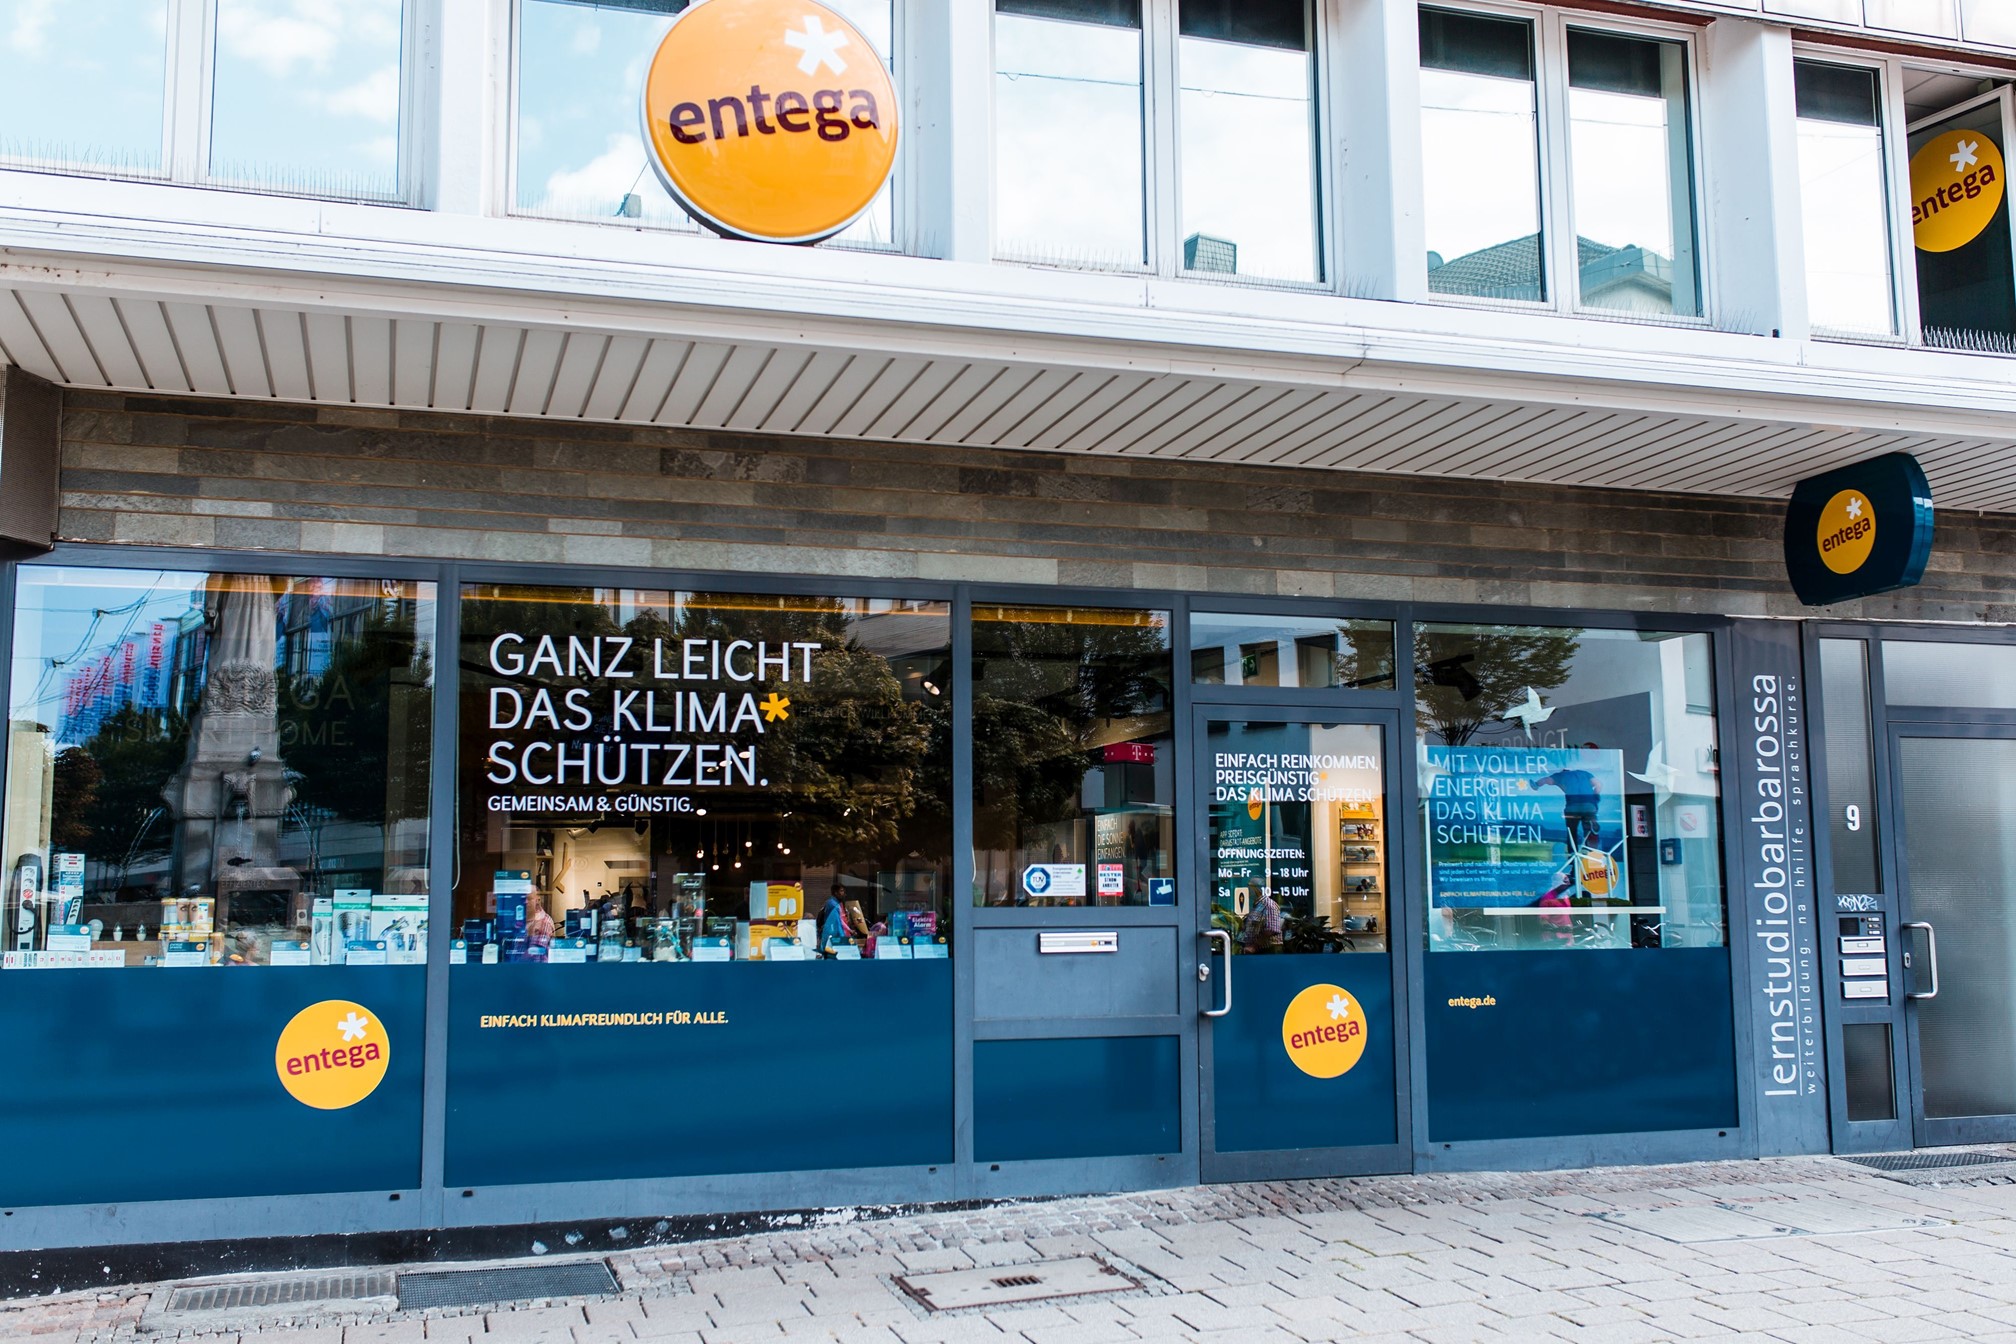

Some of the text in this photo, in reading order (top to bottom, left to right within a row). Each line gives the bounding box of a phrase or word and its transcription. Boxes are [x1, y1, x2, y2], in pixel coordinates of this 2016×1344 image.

[669, 85, 880, 144] entega
[1912, 164, 1996, 225] entega
[1822, 517, 1871, 552] entega
[489, 633, 822, 682] GANZ LEICHT
[489, 687, 765, 733] DAS KLIMA
[1787, 676, 1803, 805] sprachkurse.
[486, 735, 769, 787] SCHÜTZEN.
[1132, 745, 1141, 760] T
[1215, 753, 1379, 771] EINFACH REINKOMMEN,
[1434, 754, 1467, 773] MIT
[1474, 755, 1549, 774] VOLLER
[1216, 768, 1320, 785] PREISGÜNSTIG
[1216, 785, 1376, 802] DAS KLIMA SCHÜTZEN.
[1435, 778, 1518, 797] ENERGIE
[487, 793, 694, 813] GEMEINSAM & GÜNSTIG.
[1436, 801, 1544, 821] DAS KLIMA
[1097, 817, 1118, 832] EINFACH
[1846, 804, 1860, 831] 9
[1097, 832, 1124, 846] DIE SONNE
[1437, 823, 1547, 844] SCHÜTZEN.
[1217, 848, 1305, 859] ÖFFNUNGSZEITEN:
[1218, 868, 1233, 878] Mo
[1241, 868, 1251, 877] Fr
[1265, 868, 1271, 878] 9
[1280, 868, 1290, 878] 18
[1291, 867, 1309, 877] Uhr
[1218, 887, 1231, 897] Sa
[1260, 887, 1272, 897] 10
[1280, 887, 1290, 897] 15
[1291, 886, 1310, 896] Uhr
[1751, 674, 1797, 1096] lernstudiobarbarossa
[1448, 995, 1496, 1009] entega.de
[480, 1010, 729, 1028] EINFACH KLIMAFREUNDLICH FÜR ALLE.
[1800, 938, 1816, 1094] weiterbildung.
[1291, 1020, 1360, 1049] entega
[286, 1042, 380, 1076] entega
